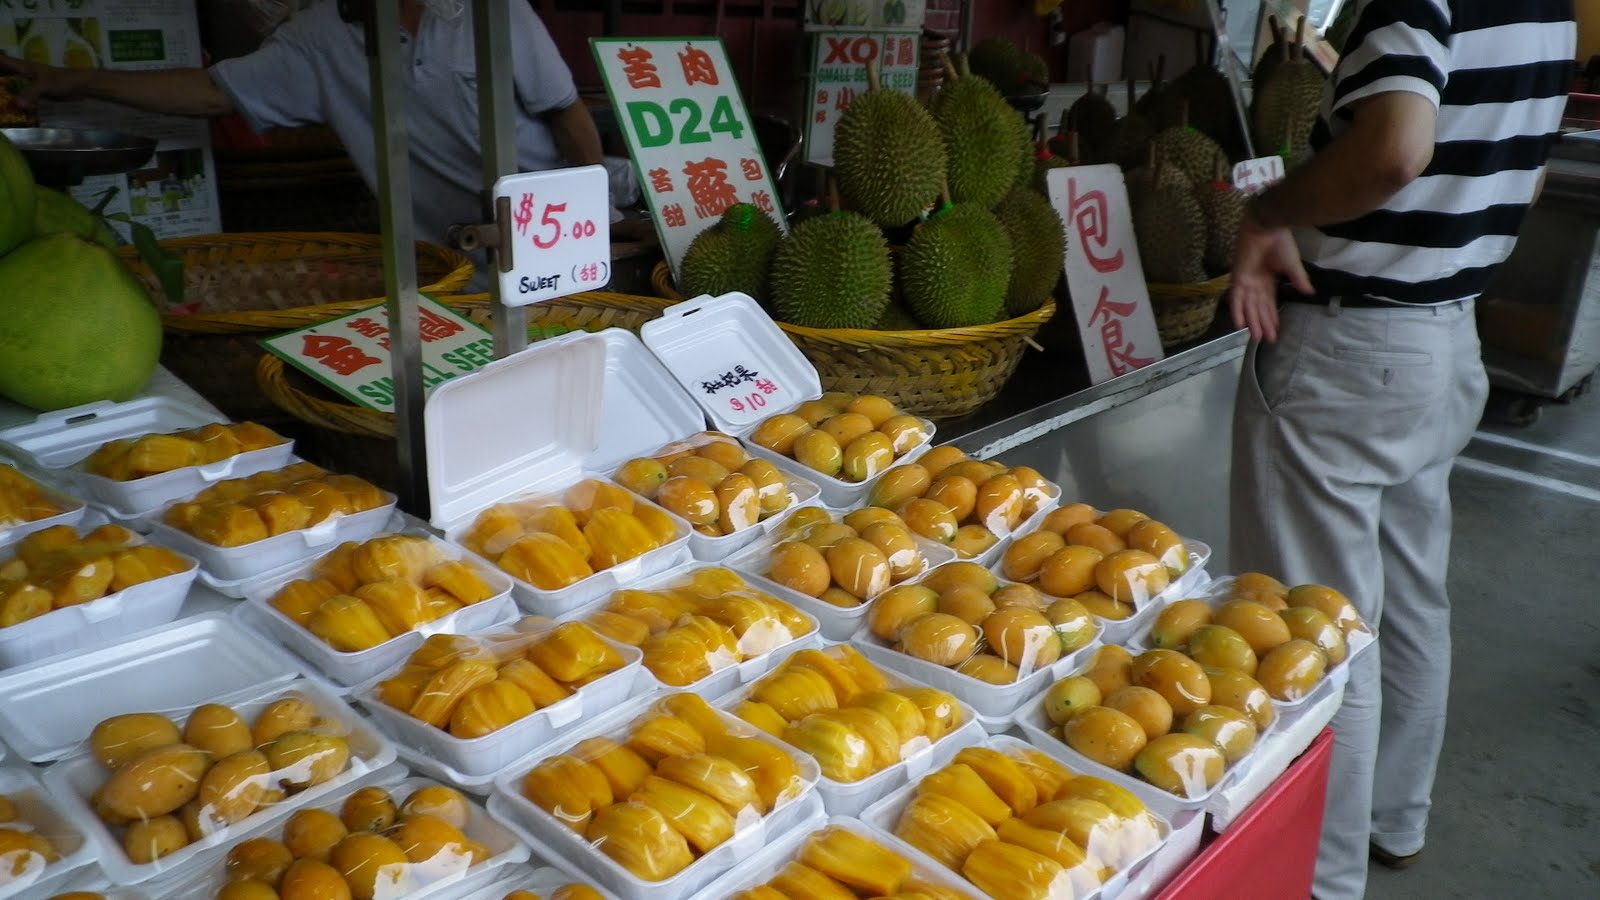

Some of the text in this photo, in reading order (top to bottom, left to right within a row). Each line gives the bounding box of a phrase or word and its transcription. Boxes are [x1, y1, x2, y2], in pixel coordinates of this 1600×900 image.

[823, 37, 879, 65] XO
[626, 95, 744, 148] D24
[513, 192, 596, 250] $5.00
[518, 274, 561, 294] SWEET
[1066, 176, 1155, 377] 包食
[357, 361, 456, 406] SMLL
[729, 392, 767, 413] $10
